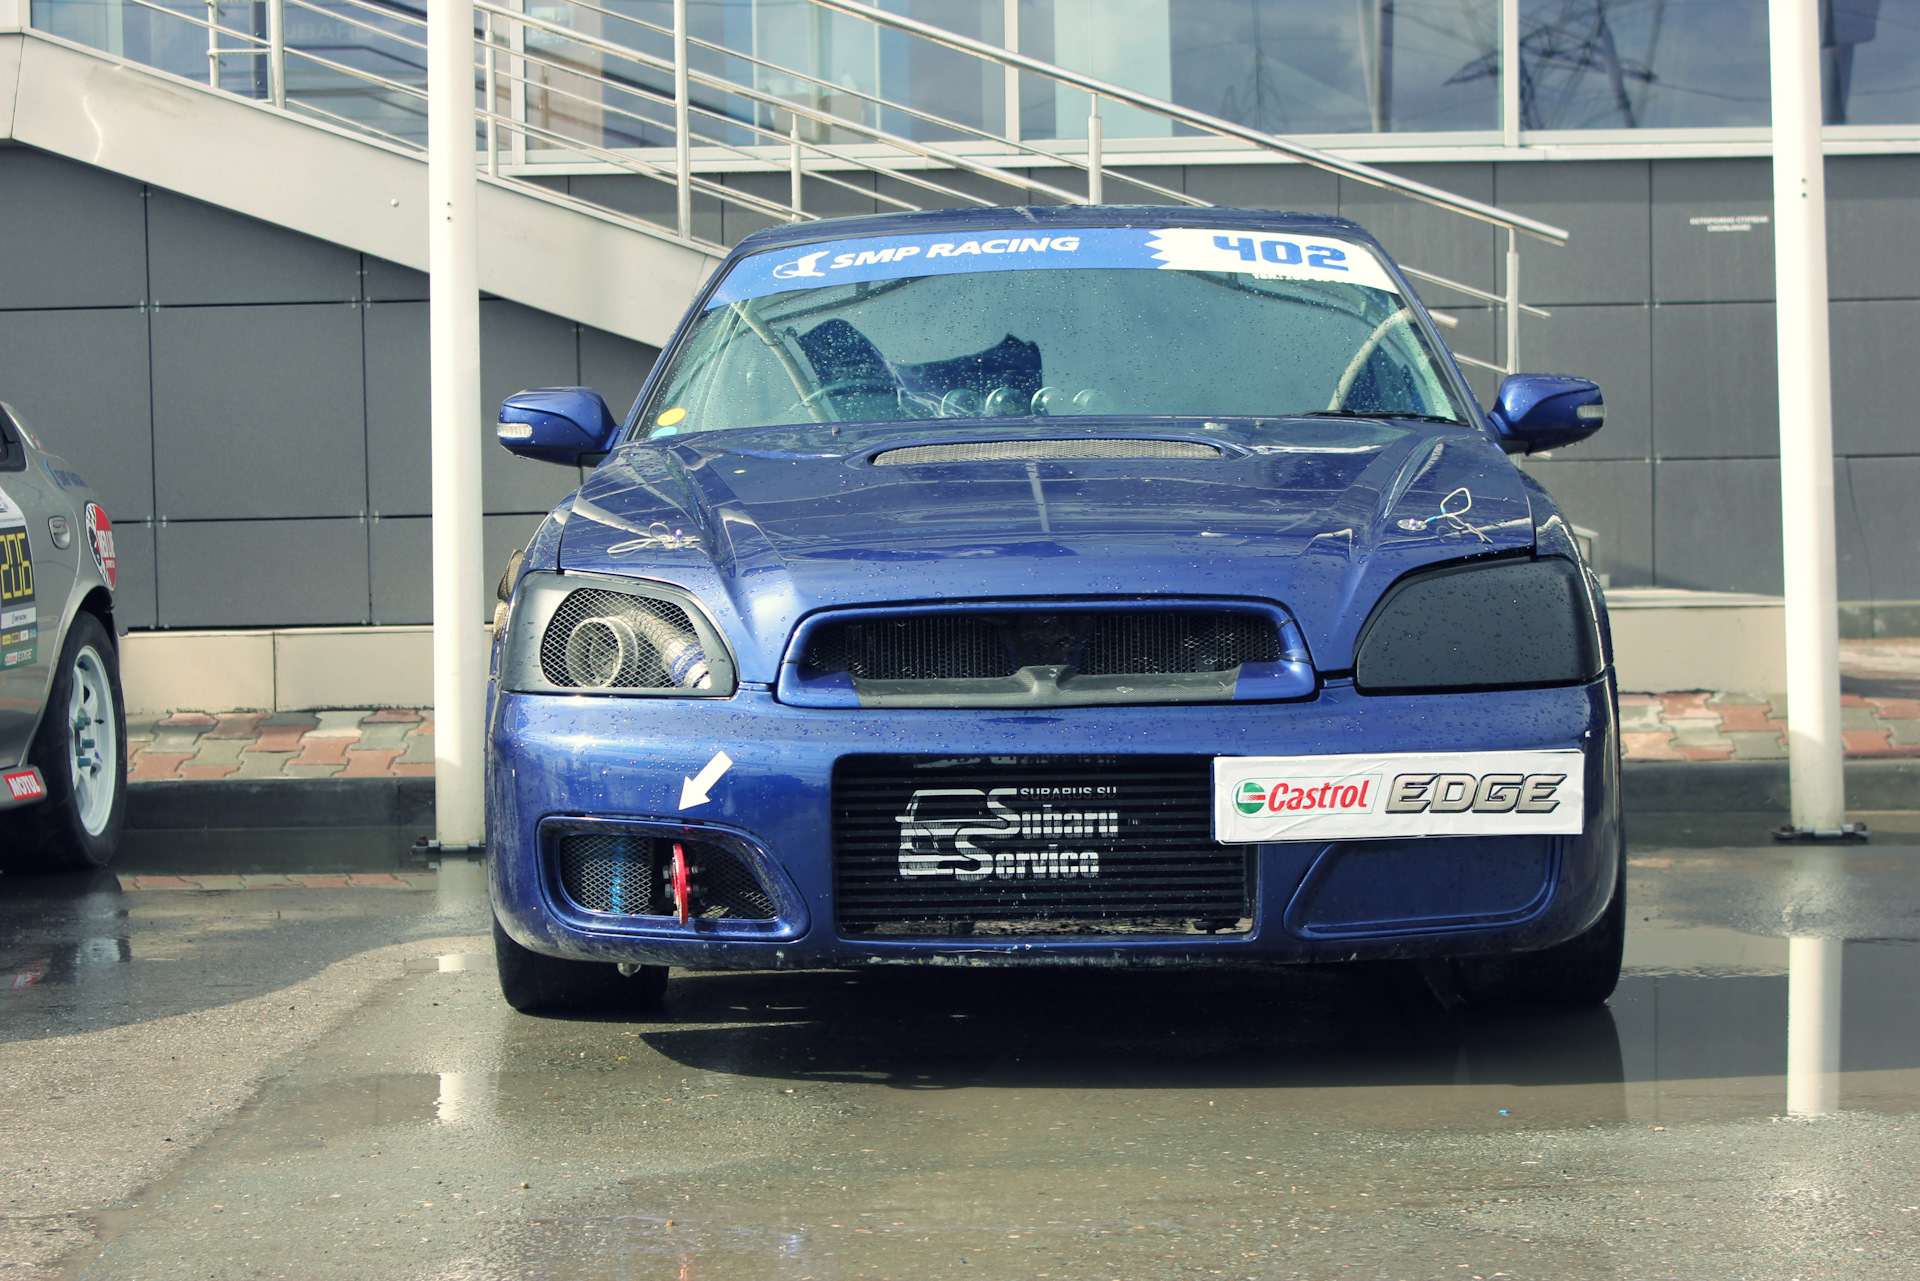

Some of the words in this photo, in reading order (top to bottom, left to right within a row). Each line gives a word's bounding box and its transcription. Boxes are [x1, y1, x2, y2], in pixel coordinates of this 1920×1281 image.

[830, 246, 920, 269] SMP
[926, 236, 1080, 259] RACING
[1213, 235, 1350, 272] 402
[8, 774, 41, 797] MOTUL
[1268, 779, 1370, 812] Castrol
[1385, 773, 1567, 815] EDGE
[986, 788, 1119, 839] Subaru
[954, 827, 1100, 882] Service
